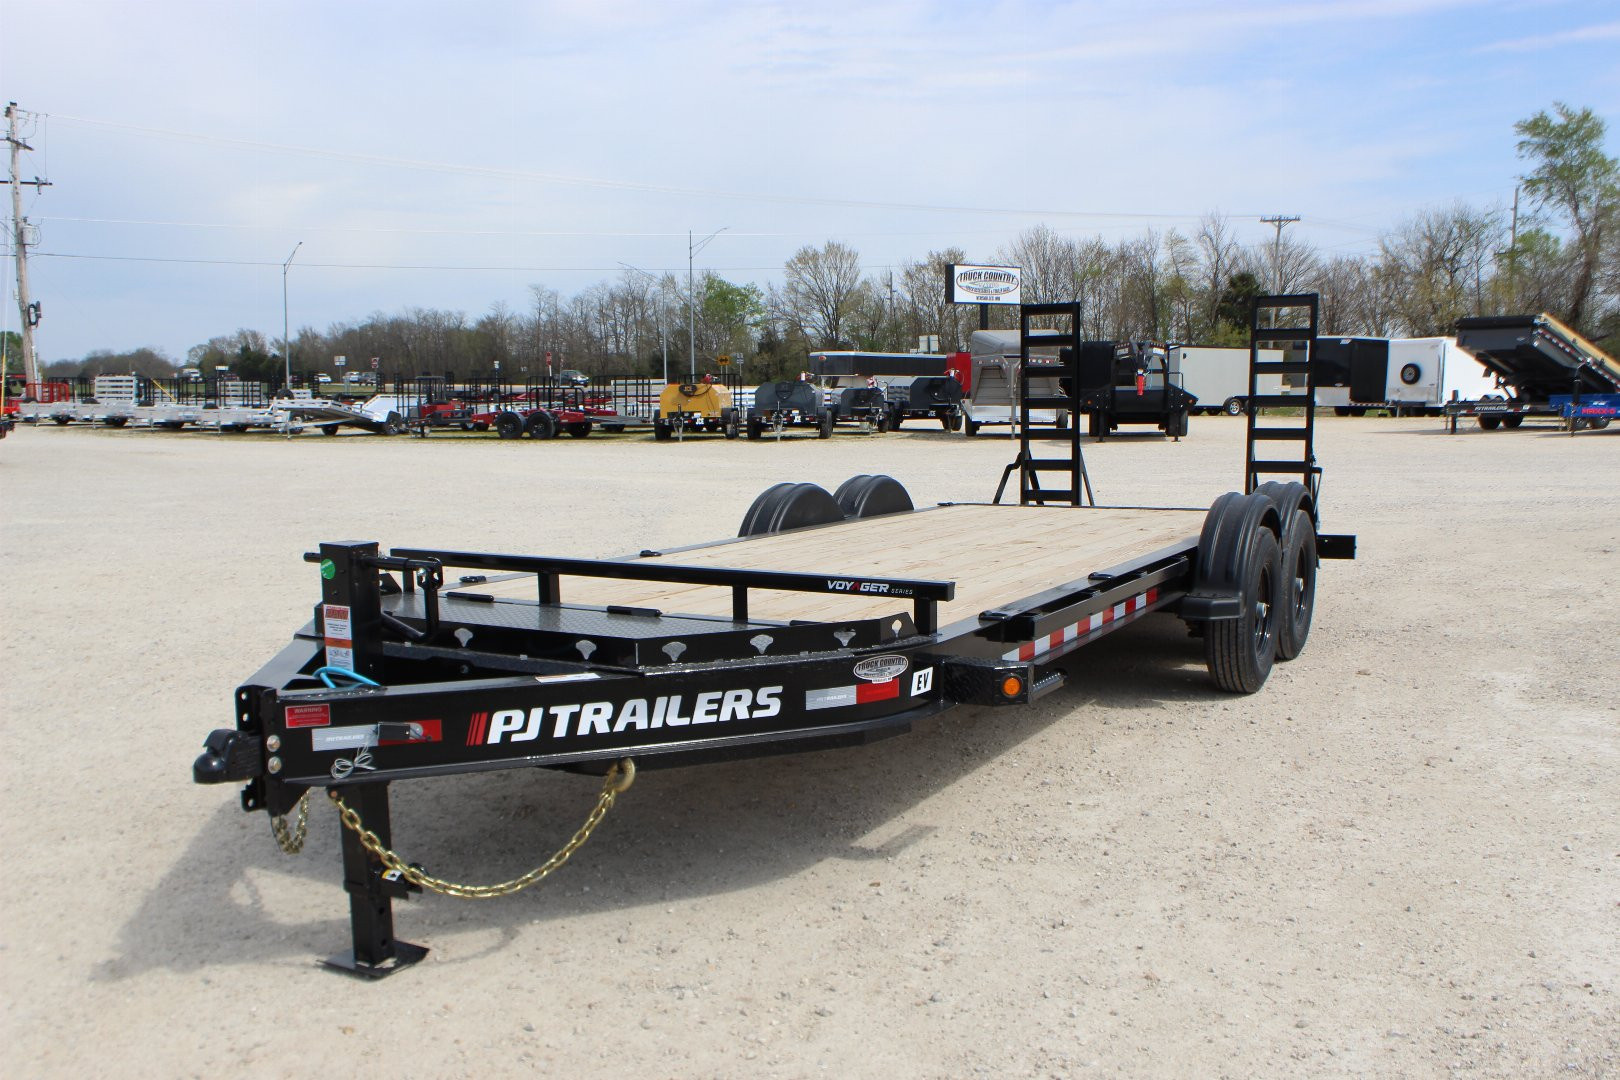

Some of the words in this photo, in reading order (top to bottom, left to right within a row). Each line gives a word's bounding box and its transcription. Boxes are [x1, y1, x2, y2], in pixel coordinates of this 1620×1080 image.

[959, 271, 983, 282] TRUCK
[983, 271, 1016, 282] COUNTRY
[826, 580, 890, 593] VOYAGER
[857, 659, 880, 671] TRUCK
[879, 657, 905, 668] COUNTRY
[916, 671, 930, 691] EV
